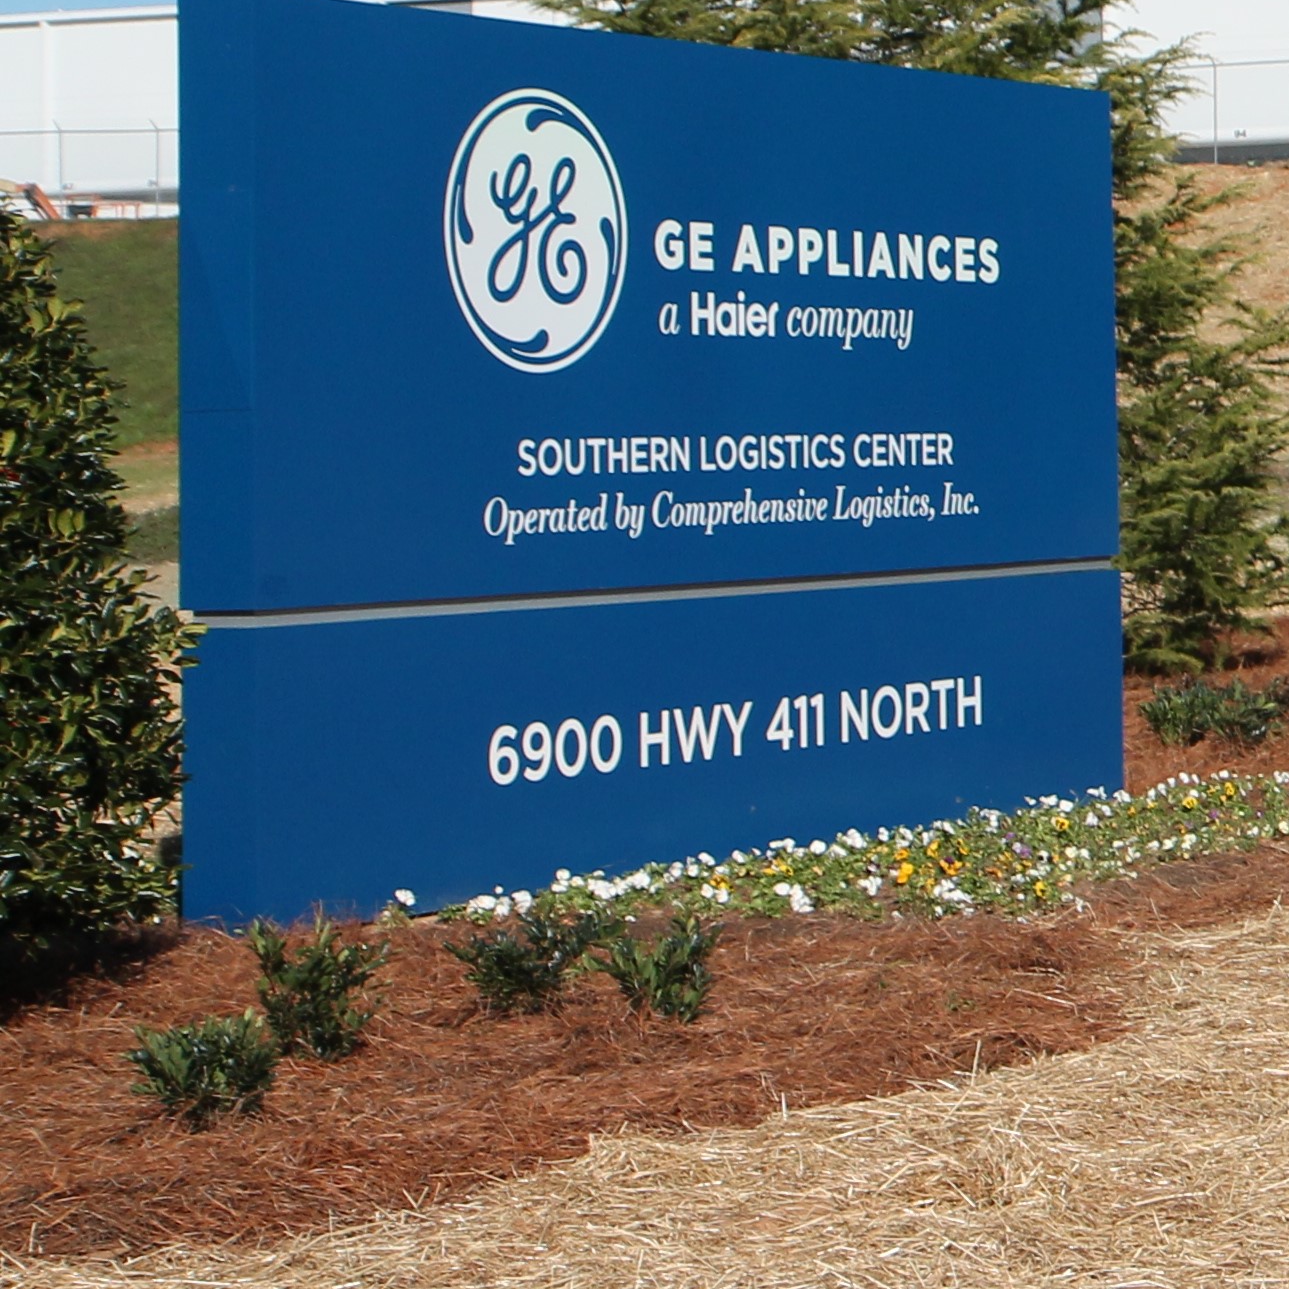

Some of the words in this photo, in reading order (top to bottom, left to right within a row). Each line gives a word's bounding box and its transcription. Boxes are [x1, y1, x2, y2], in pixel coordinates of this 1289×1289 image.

[654, 219, 714, 271] GE
[731, 224, 1000, 284] APPLIANCES
[658, 302, 680, 335] a
[690, 290, 779, 337] Haier
[786, 306, 914, 350] company
[517, 433, 690, 477] SOUTHERN
[700, 433, 846, 471] LOGISTICS
[853, 433, 954, 468] CENTER
[483, 490, 608, 546] Operated
[615, 492, 645, 539] by
[651, 487, 828, 535] Comprehensive
[832, 485, 936, 528] Logistics,
[940, 482, 981, 516] Inc.
[488, 714, 622, 786] 6900
[639, 701, 753, 768] HWY
[765, 693, 825, 751] 411
[840, 675, 982, 743] NORTH
